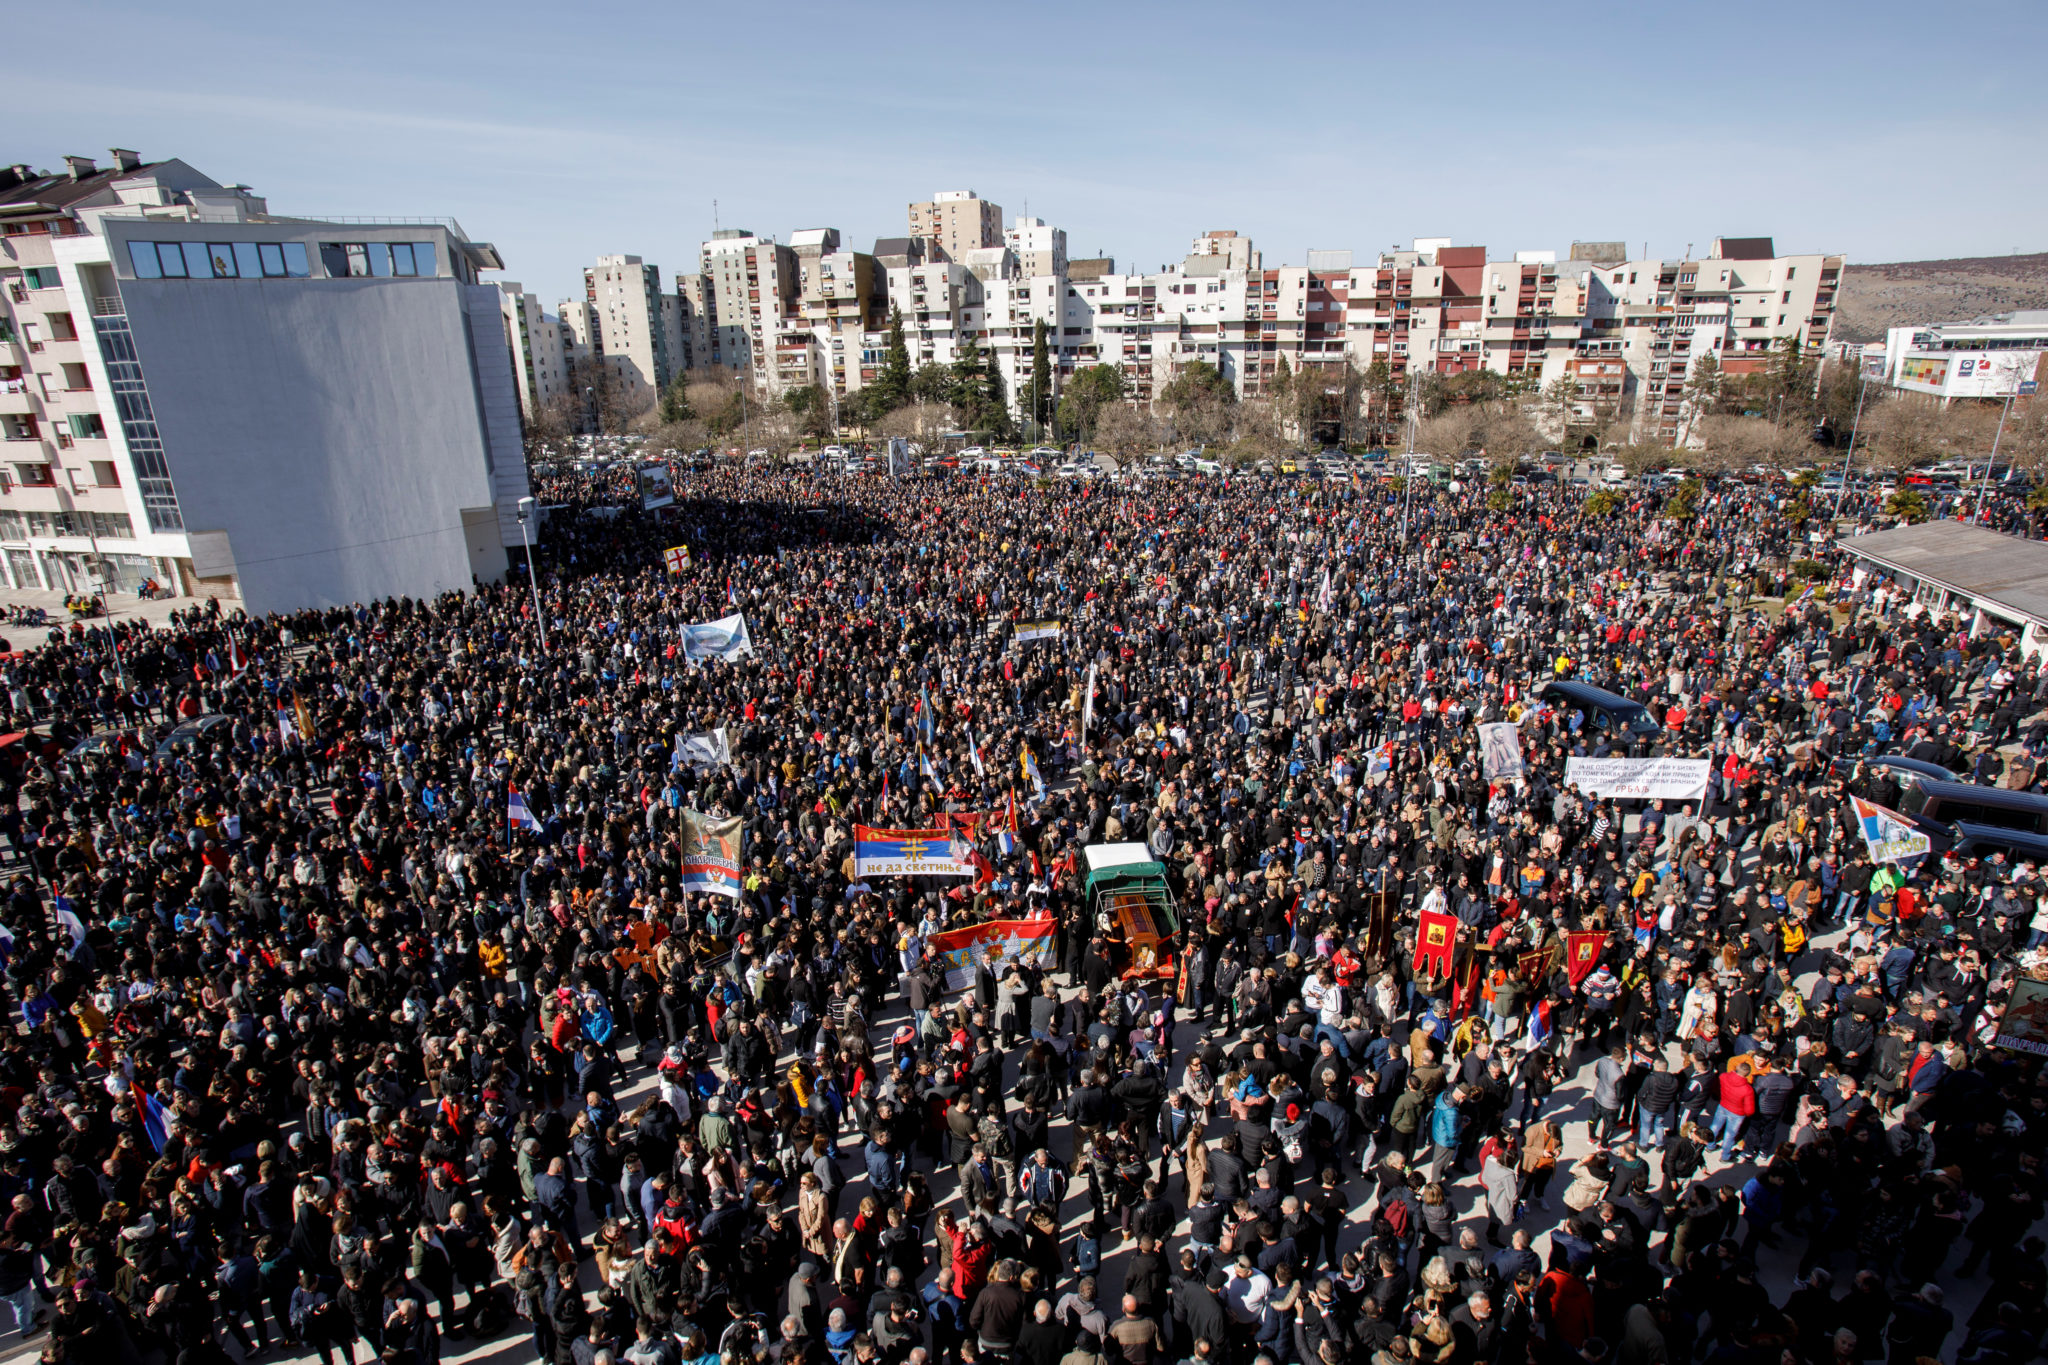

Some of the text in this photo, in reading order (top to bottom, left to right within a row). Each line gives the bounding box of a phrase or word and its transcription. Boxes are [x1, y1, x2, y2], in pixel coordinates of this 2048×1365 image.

[1615, 785, 1650, 793] ГРБАЉ
[867, 863, 963, 873] НЕ ДА СВЕТИЊЕ
